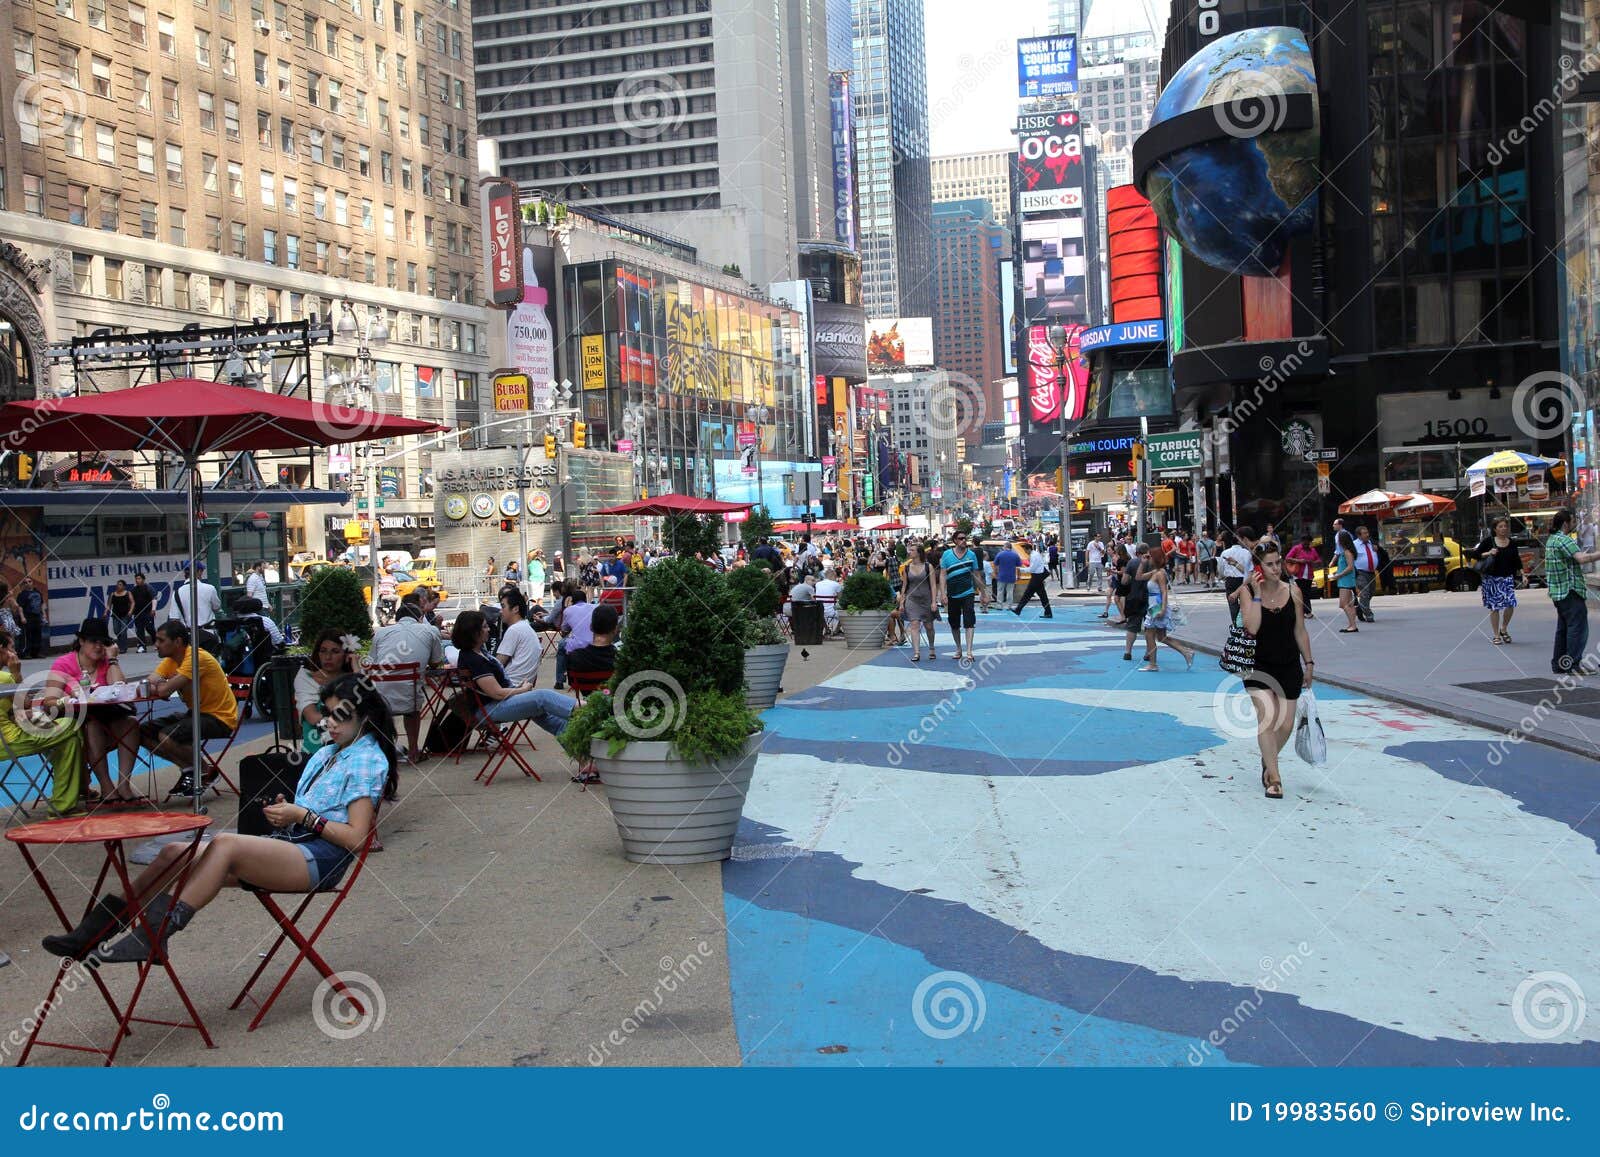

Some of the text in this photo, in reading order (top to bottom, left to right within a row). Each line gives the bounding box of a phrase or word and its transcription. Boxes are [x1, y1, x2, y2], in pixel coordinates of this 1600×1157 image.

[1020, 38, 1074, 54] WHEN THEY
[1023, 50, 1071, 66] COUNT ON
[1026, 63, 1069, 77] US MOST
[1019, 115, 1056, 130] HSBC
[1023, 195, 1059, 208] HSBC
[514, 326, 547, 340] 750,000
[1120, 324, 1158, 340] JUNE
[586, 345, 599, 353] THE
[585, 369, 603, 382] KING
[496, 383, 526, 396] BUBBA
[500, 398, 525, 411] GUMP
[1424, 417, 1489, 437] 1500
[1098, 438, 1134, 451] COURT
[1160, 449, 1200, 461] COFFEE
[1085, 461, 1112, 474] ESPN
[443, 479, 505, 492] RECRUITING
[48, 566, 97, 580] ELCOME
[100, 564, 113, 577] TO
[117, 562, 151, 576] TIMES
